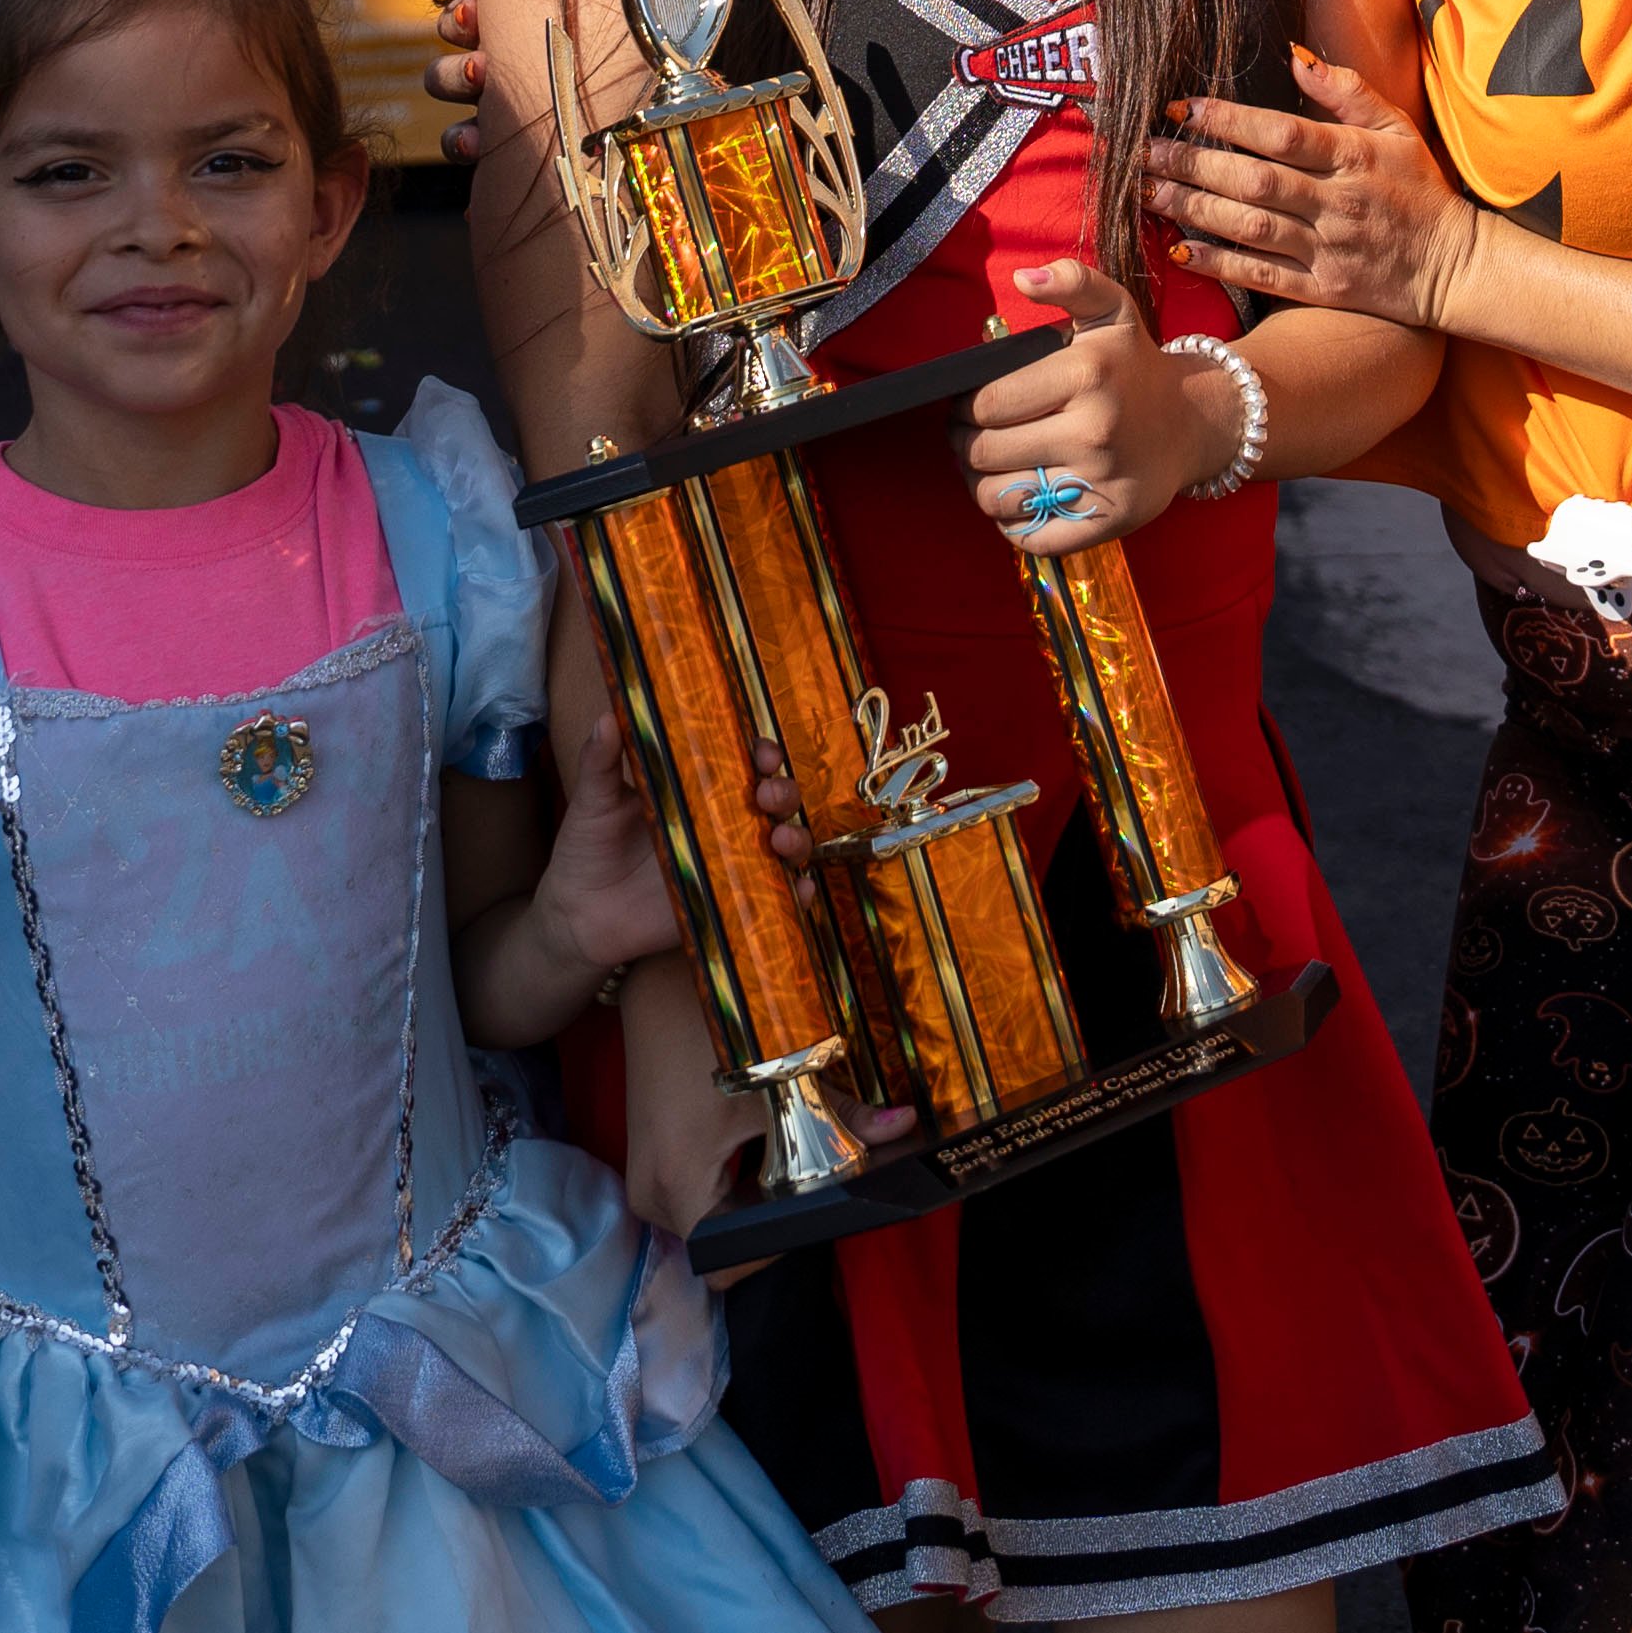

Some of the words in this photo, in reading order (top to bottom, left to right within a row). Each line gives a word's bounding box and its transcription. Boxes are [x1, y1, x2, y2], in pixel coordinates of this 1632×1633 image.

[995, 22, 1101, 83] CHEER
[852, 685, 948, 774] 2nd
[937, 1135, 994, 1165] State
[995, 1086, 1103, 1139] Employees
[1103, 1058, 1167, 1091] Credit
[1167, 1031, 1231, 1063] Union
[990, 1141, 1014, 1160] for
[1015, 1126, 1053, 1147] Kids
